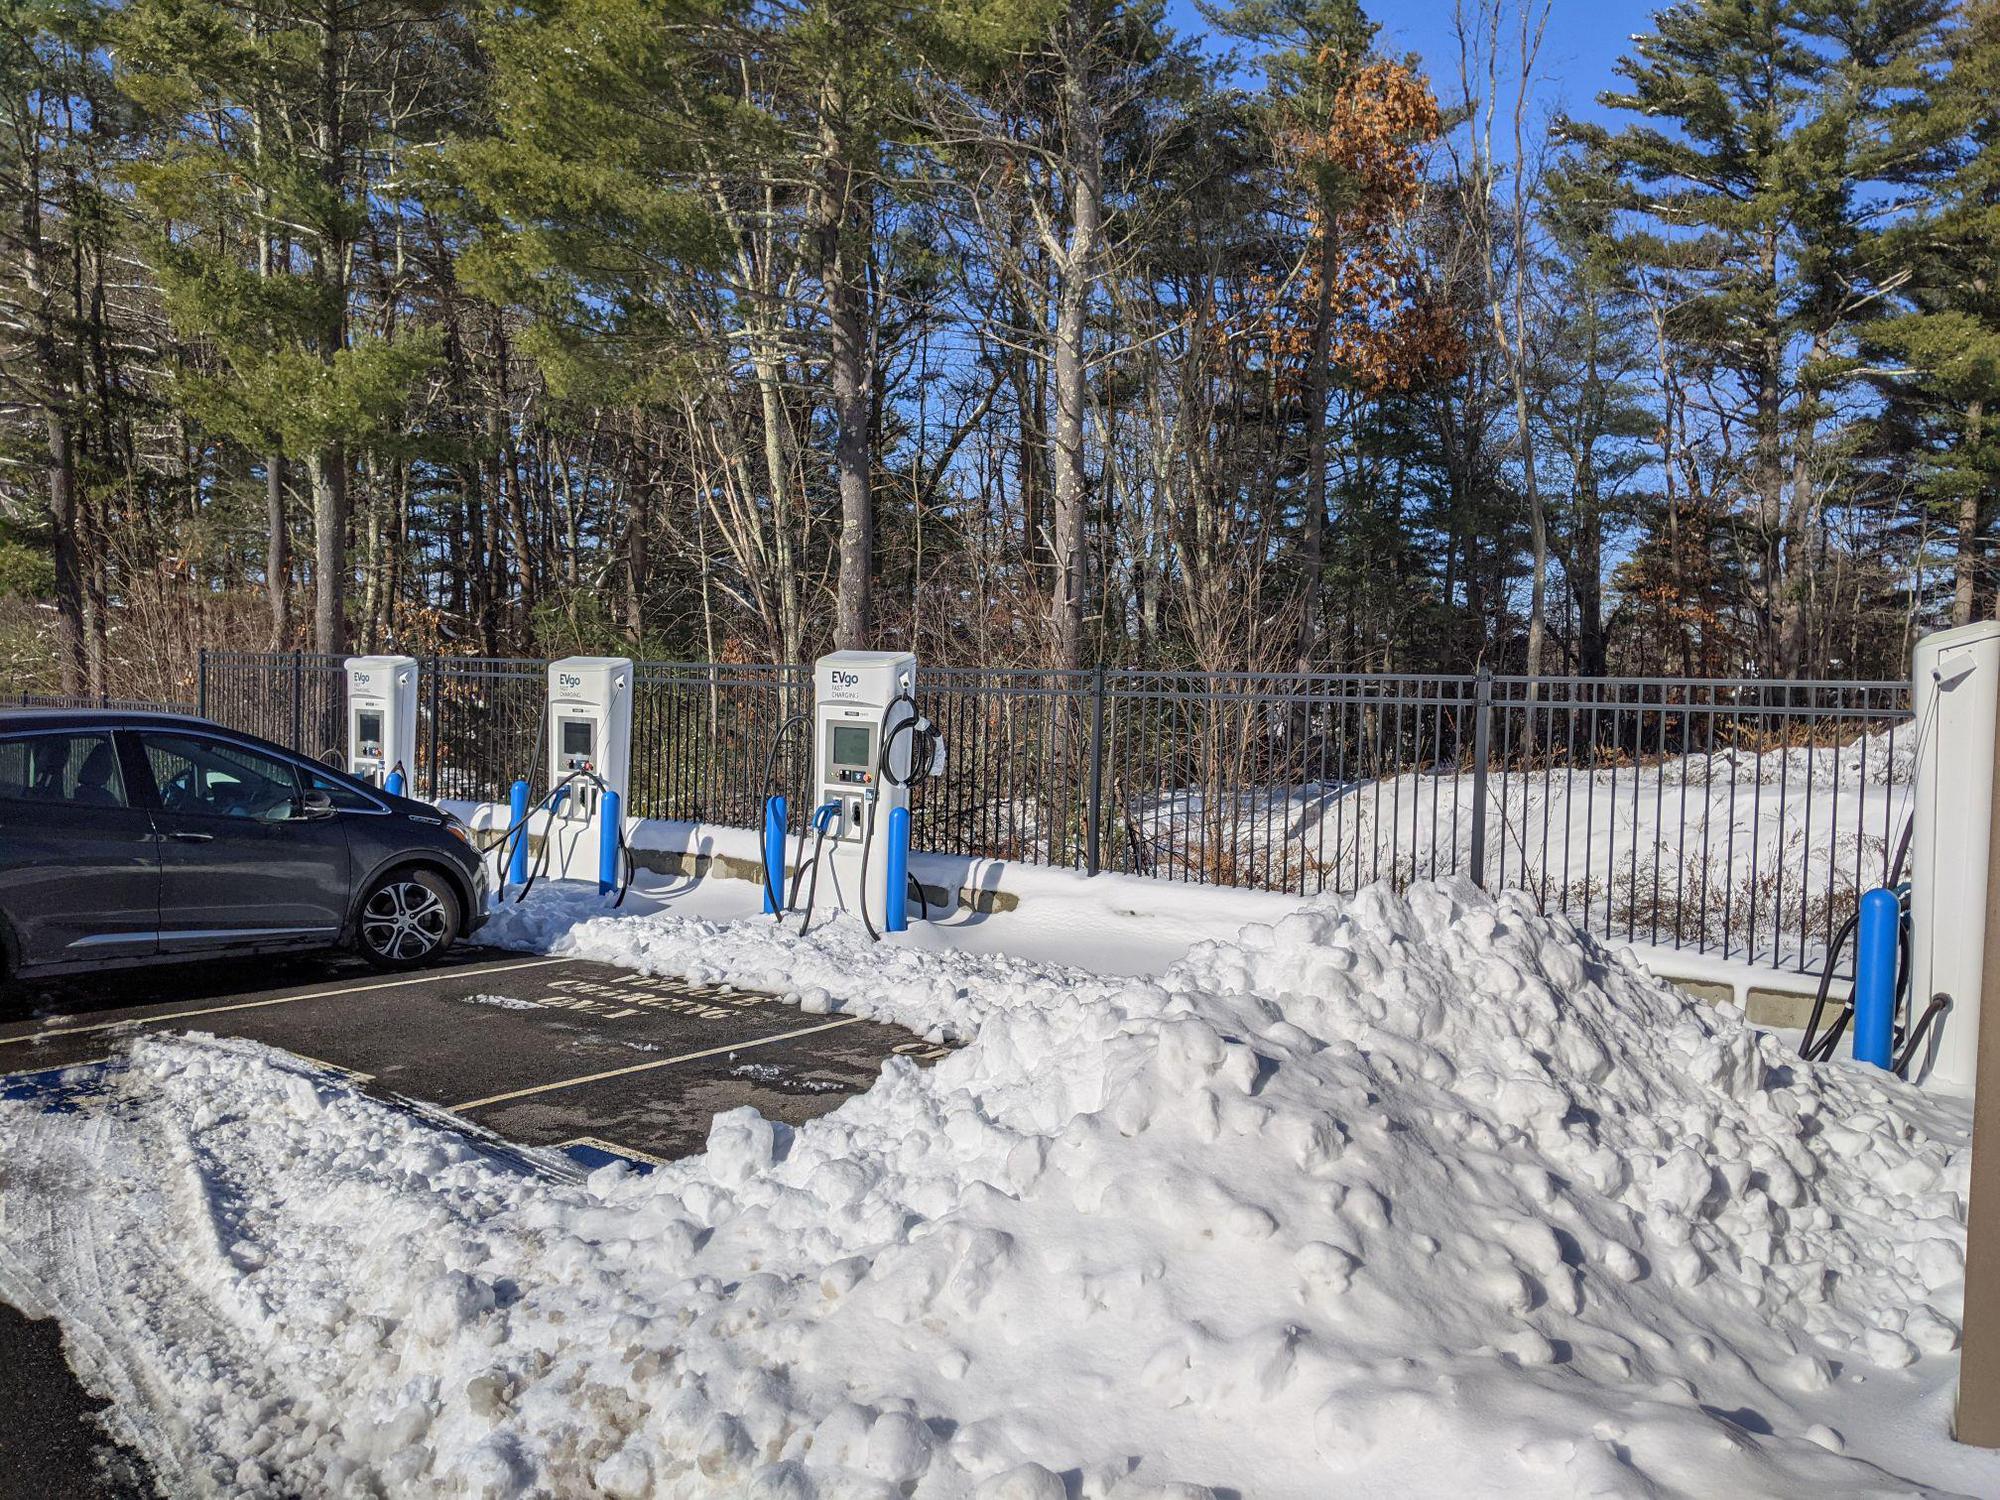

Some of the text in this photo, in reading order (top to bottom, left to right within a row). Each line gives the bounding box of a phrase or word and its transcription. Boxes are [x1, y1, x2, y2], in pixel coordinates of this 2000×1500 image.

[354, 672, 370, 684] EVgo
[560, 673, 580, 687] EVgo
[832, 671, 859, 687] EVgo
[537, 996, 650, 1019] ONLY
[546, 980, 738, 1019] CHARGING
